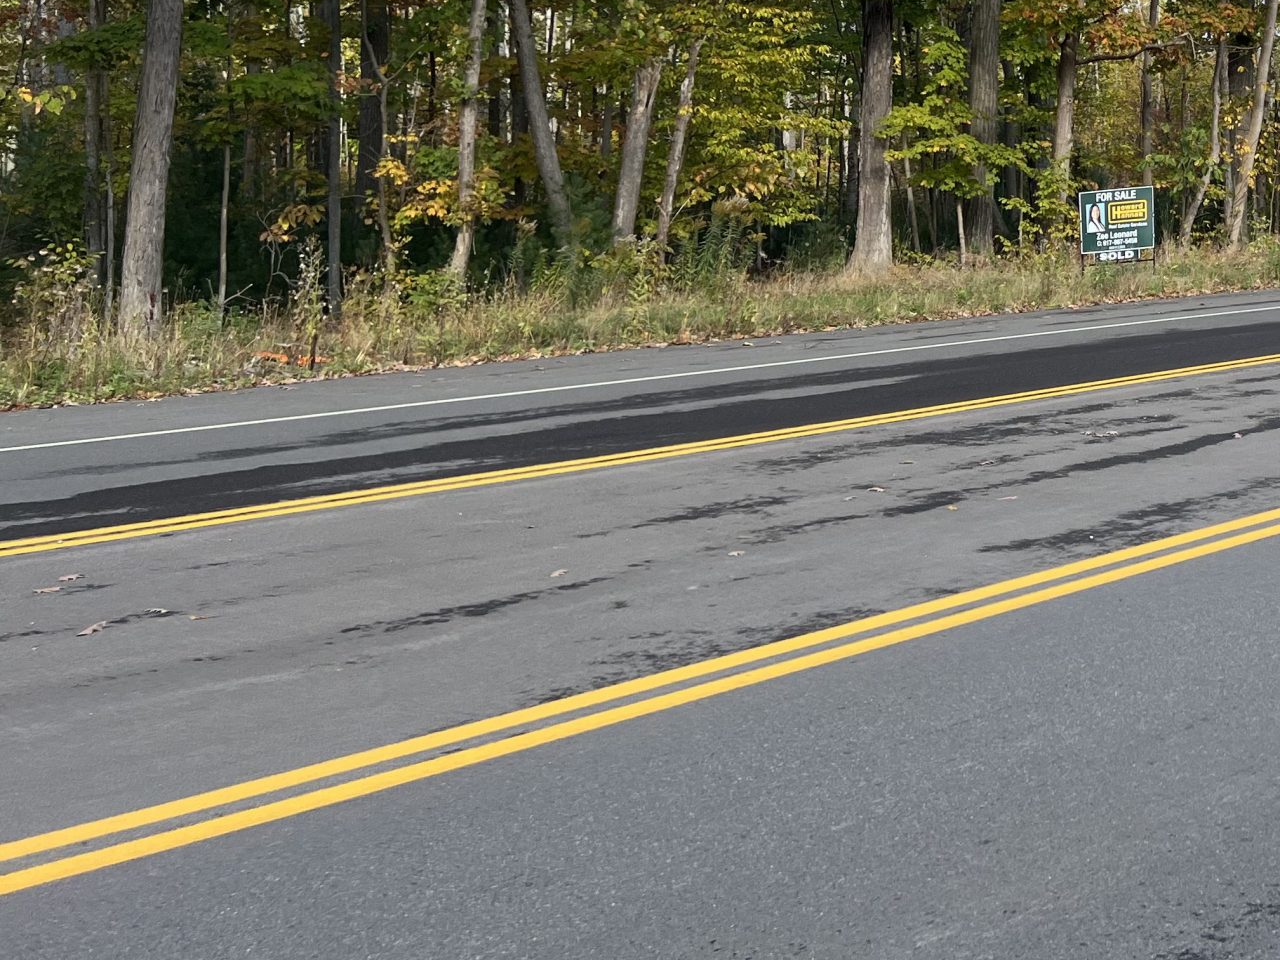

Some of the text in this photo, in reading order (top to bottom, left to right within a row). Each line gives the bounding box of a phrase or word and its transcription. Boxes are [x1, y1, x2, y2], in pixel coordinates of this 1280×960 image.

[1096, 190, 1137, 202] FOR SALE
[1112, 203, 1143, 215] Howard
[1109, 229, 1138, 239] Leonard
[1099, 250, 1135, 261] SOLD
